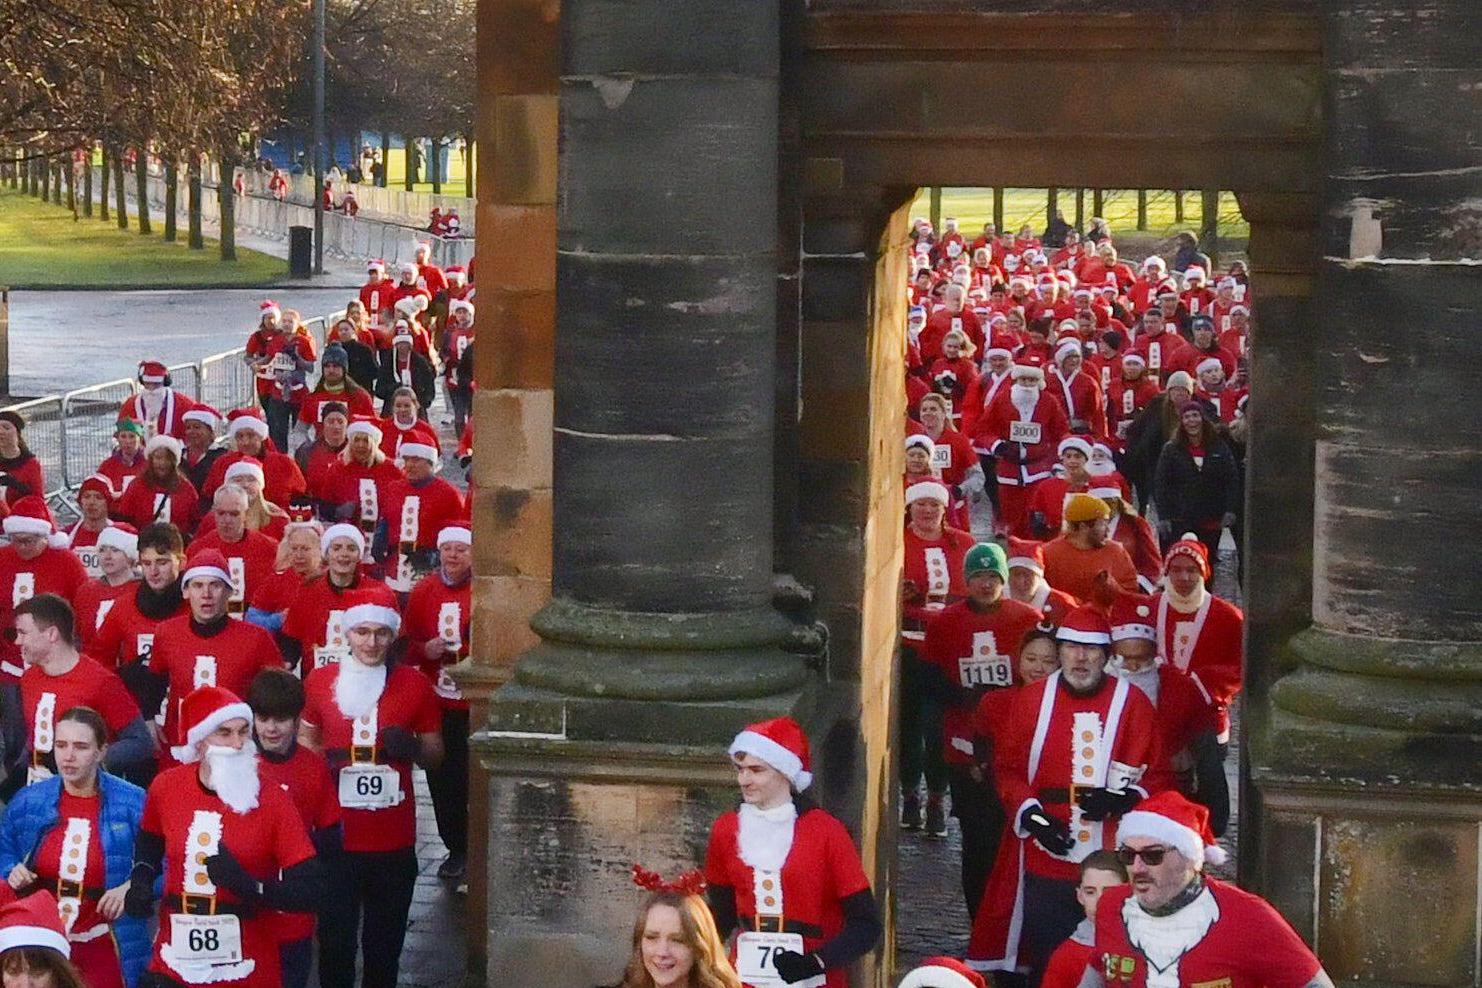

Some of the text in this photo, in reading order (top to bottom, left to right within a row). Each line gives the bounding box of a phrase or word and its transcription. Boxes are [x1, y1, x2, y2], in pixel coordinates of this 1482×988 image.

[963, 664, 1008, 684] 1119
[357, 776, 383, 796] 69
[189, 928, 219, 952] 68
